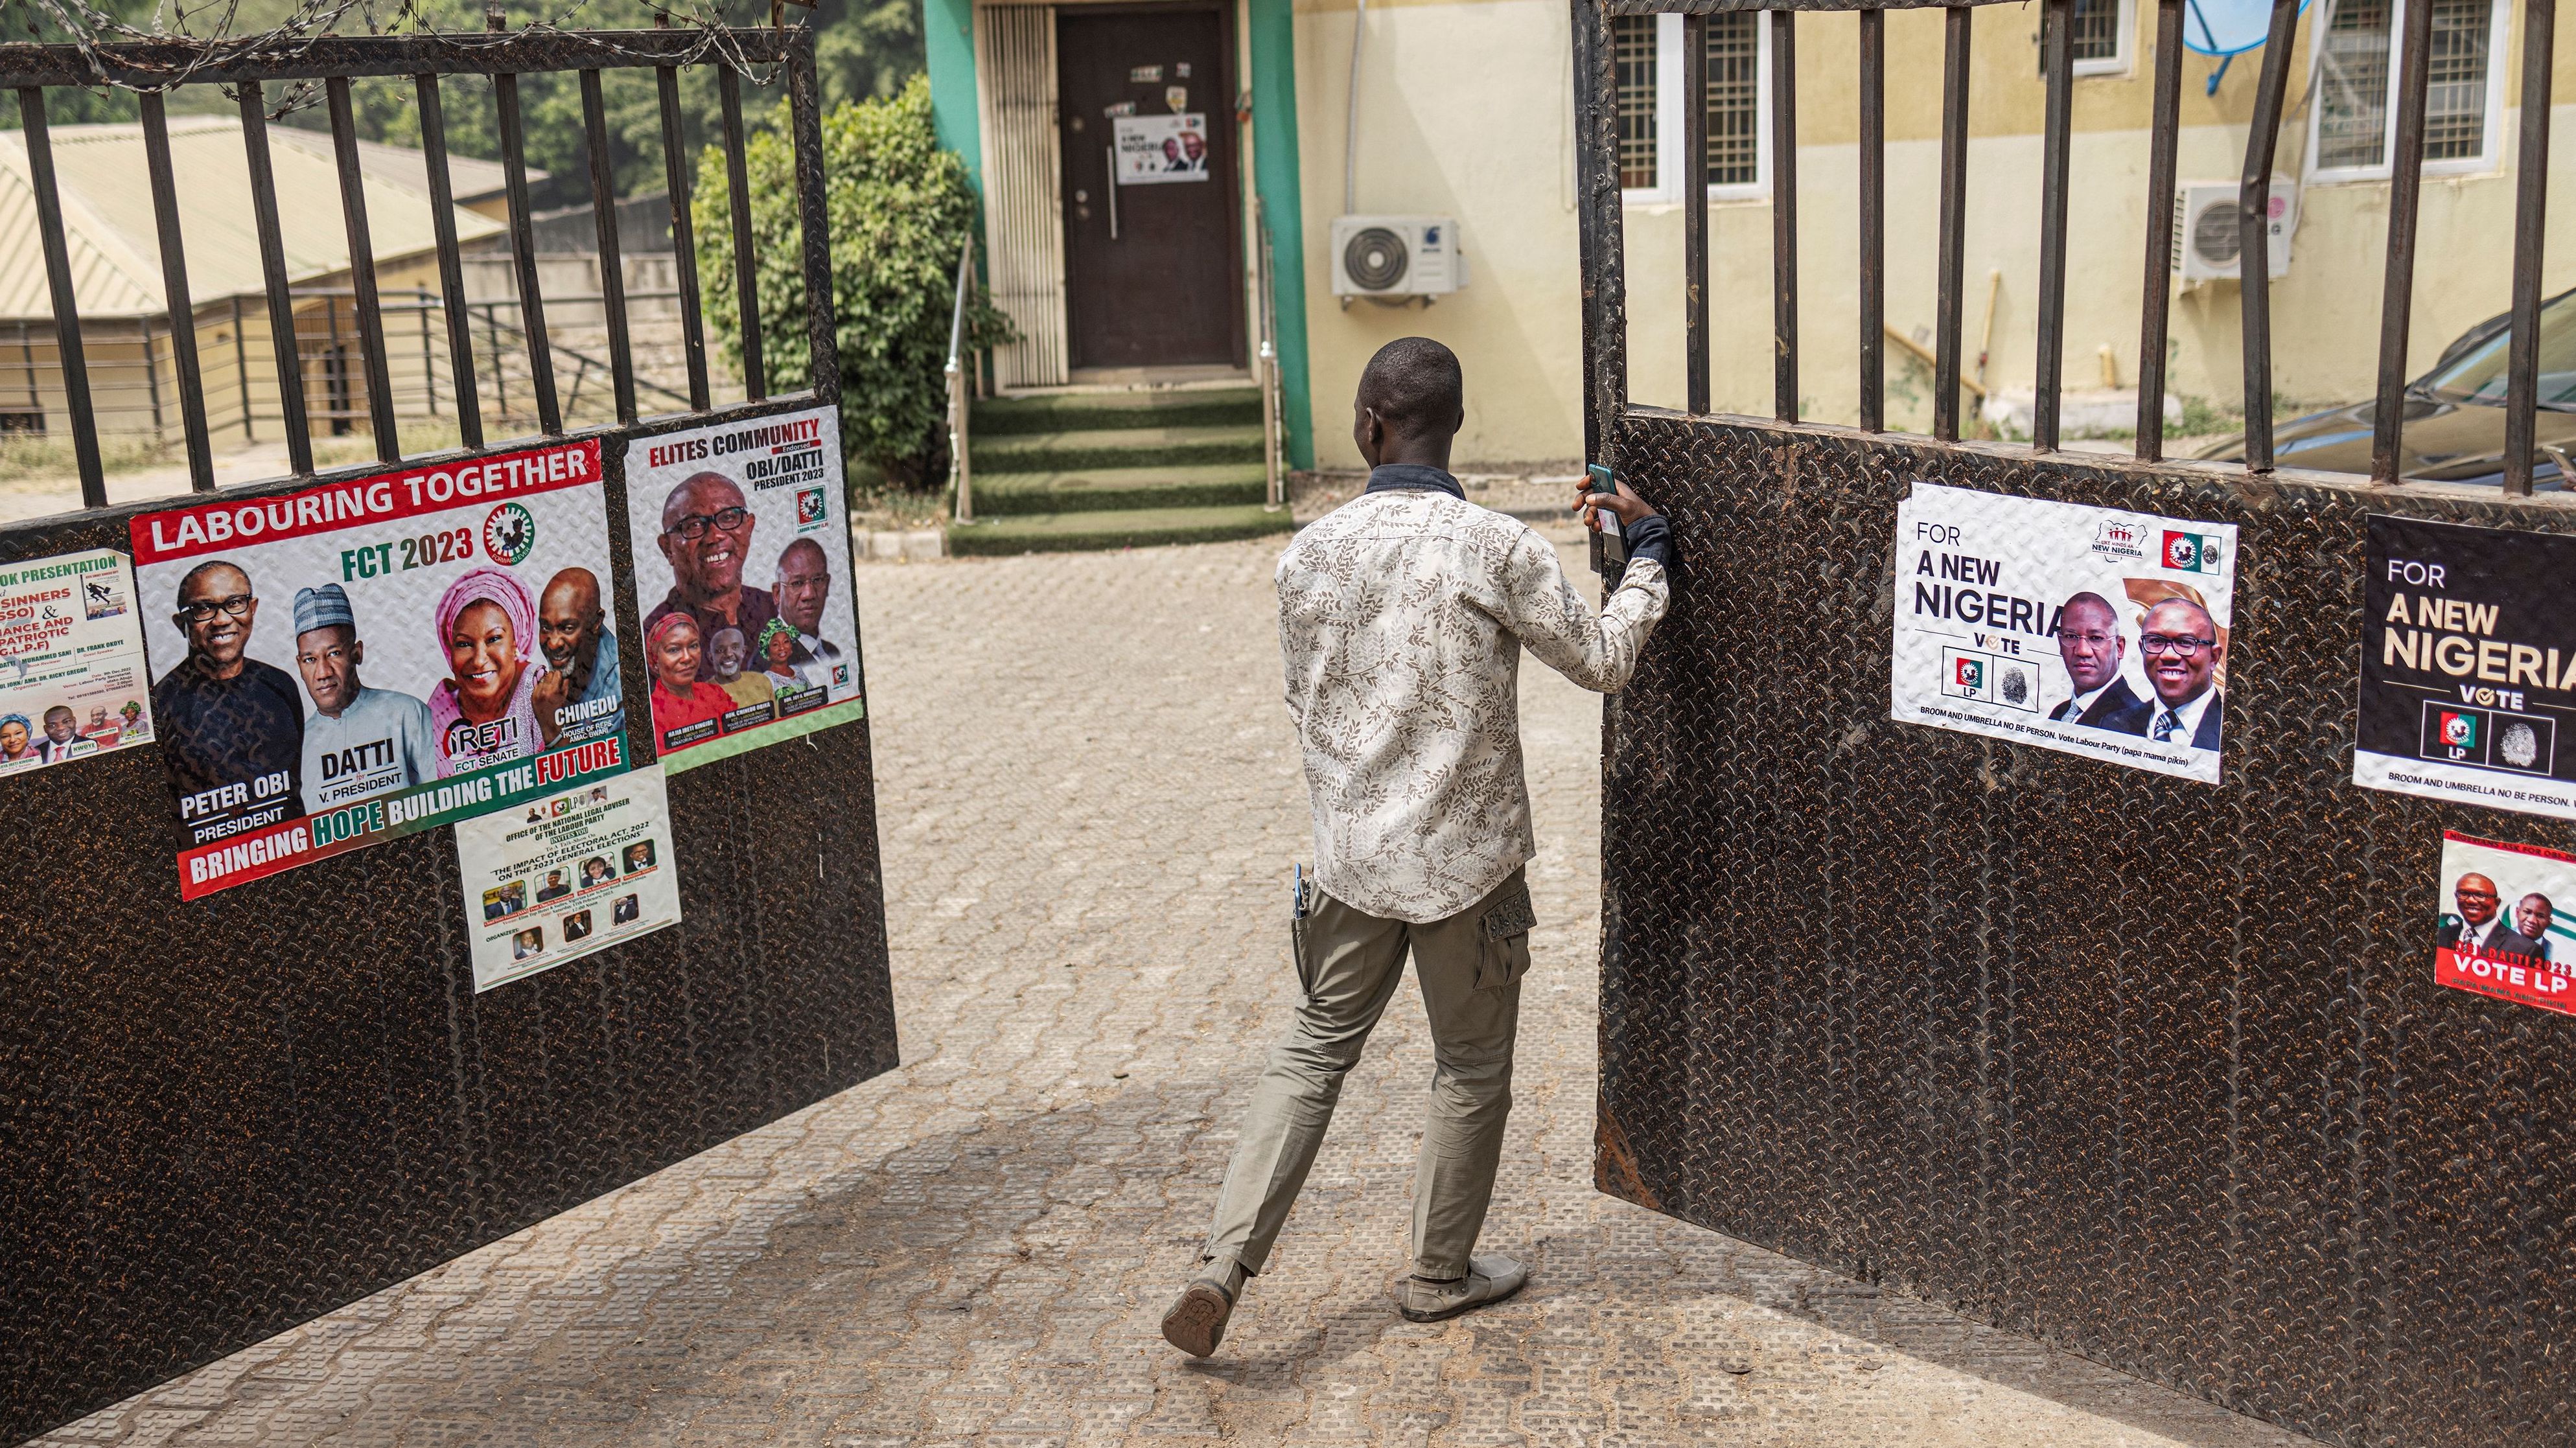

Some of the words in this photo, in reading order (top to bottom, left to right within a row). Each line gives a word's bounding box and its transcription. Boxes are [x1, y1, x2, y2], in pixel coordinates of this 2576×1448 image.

[649, 439, 708, 468] ELITES
[712, 418, 820, 456] COMMUNITY
[782, 442, 811, 452] Endorsed
[746, 449, 824, 480] OBI/DATTI
[754, 472, 800, 491] PRESIDENT
[802, 468, 824, 481] 2023
[151, 481, 394, 553] LABOURING
[404, 448, 587, 507] TOGETHER
[1917, 522, 1960, 547] FOR
[341, 542, 393, 582] FCT
[399, 527, 474, 571] 2023
[493, 554, 518, 564] FORWARD
[518, 547, 531, 560] EVER
[2092, 544, 2110, 553] NEW
[2111, 547, 2142, 557] NIGERIA
[21, 555, 117, 583] PRESENTATION
[1917, 550, 1934, 577] A
[1942, 553, 2001, 585] NEW
[2387, 559, 2446, 589] FOR
[1, 588, 71, 608] SINNERS
[42, 605, 60, 620] &
[44, 616, 74, 629] AND
[2386, 593, 2411, 624] A
[2418, 596, 2499, 636] NEW
[0, 627, 69, 646] PATRIOTIC
[1973, 632, 2020, 654] VOTE
[22, 652, 57, 664] MUHAMMED
[58, 650, 72, 658] SANI
[87, 643, 105, 652] FRANK
[106, 639, 124, 649] OKOYE
[13, 682, 42, 691] Organisers
[49, 671, 66, 680] RICKY
[66, 667, 88, 676] GREGOR
[1964, 687, 1977, 698] LP
[2459, 684, 2524, 711] VOTE
[554, 695, 618, 726] CHINEDU
[451, 717, 518, 754] IRETI
[563, 728, 585, 739] HOUSE
[1920, 706, 1946, 717] BROOM
[1947, 709, 1963, 720] AND
[1964, 713, 2002, 727] UMBRELLA
[2003, 721, 2013, 731] NO
[2016, 723, 2026, 733] BE
[2026, 726, 2056, 740] PERSON.
[2059, 733, 2074, 743] Vote
[2076, 737, 2100, 749] Labour
[2102, 742, 2120, 754] Party
[2122, 745, 2142, 758] (papa
[2143, 752, 2166, 762] mama
[2167, 755, 2188, 768] pikin)
[321, 738, 395, 781] DATTI
[455, 761, 476, 773] FCT
[479, 748, 519, 766] SENATE
[2448, 746, 2466, 760] LP
[180, 782, 249, 819] PETER
[254, 770, 291, 799] OBI
[319, 793, 329, 803] V.
[333, 772, 402, 798] PRESIDENT
[2388, 772, 2422, 785] BROOM
[2423, 777, 2443, 788] AND
[2444, 781, 2496, 796] UMBRELLA
[2498, 788, 2512, 798] NO
[2514, 792, 2527, 801] BE
[2528, 794, 2570, 807] PERSON.
[190, 826, 308, 884] BRINGING
[311, 799, 385, 849] HOPE
[388, 777, 492, 827] BUILDING
[495, 764, 534, 796] THE
[535, 737, 621, 787] FUTURE
[570, 796, 578, 810] LP
[194, 807, 285, 844] PRESIDENT
[506, 829, 528, 842] OFFICE
[528, 826, 539, 835] OF
[539, 823, 551, 833] THE
[552, 813, 583, 829] NATIONAL
[585, 807, 603, 818] LEGAL
[603, 798, 630, 812] ADVISER
[535, 832, 544, 841] OF
[544, 829, 557, 839] THE
[558, 822, 584, 836] LABOUR
[585, 814, 605, 825] PARTY
[513, 856, 545, 870] IMPACT
[547, 849, 559, 859] OF
[561, 836, 605, 855] ELECTORAL
[630, 821, 649, 832] 2022
[2523, 846, 2541, 856] FOR
[498, 873, 513, 882] ON
[513, 868, 533, 877] THE
[533, 860, 554, 870] 2023
[556, 848, 595, 863] GENERAL
[2453, 953, 2525, 986] VOTE
[2534, 972, 2568, 993] LP
[2535, 957, 2572, 976] 2023
[2452, 977, 2477, 989] PAPA
[2480, 985, 2511, 996] MAMA
[2514, 993, 2536, 1003] AND
